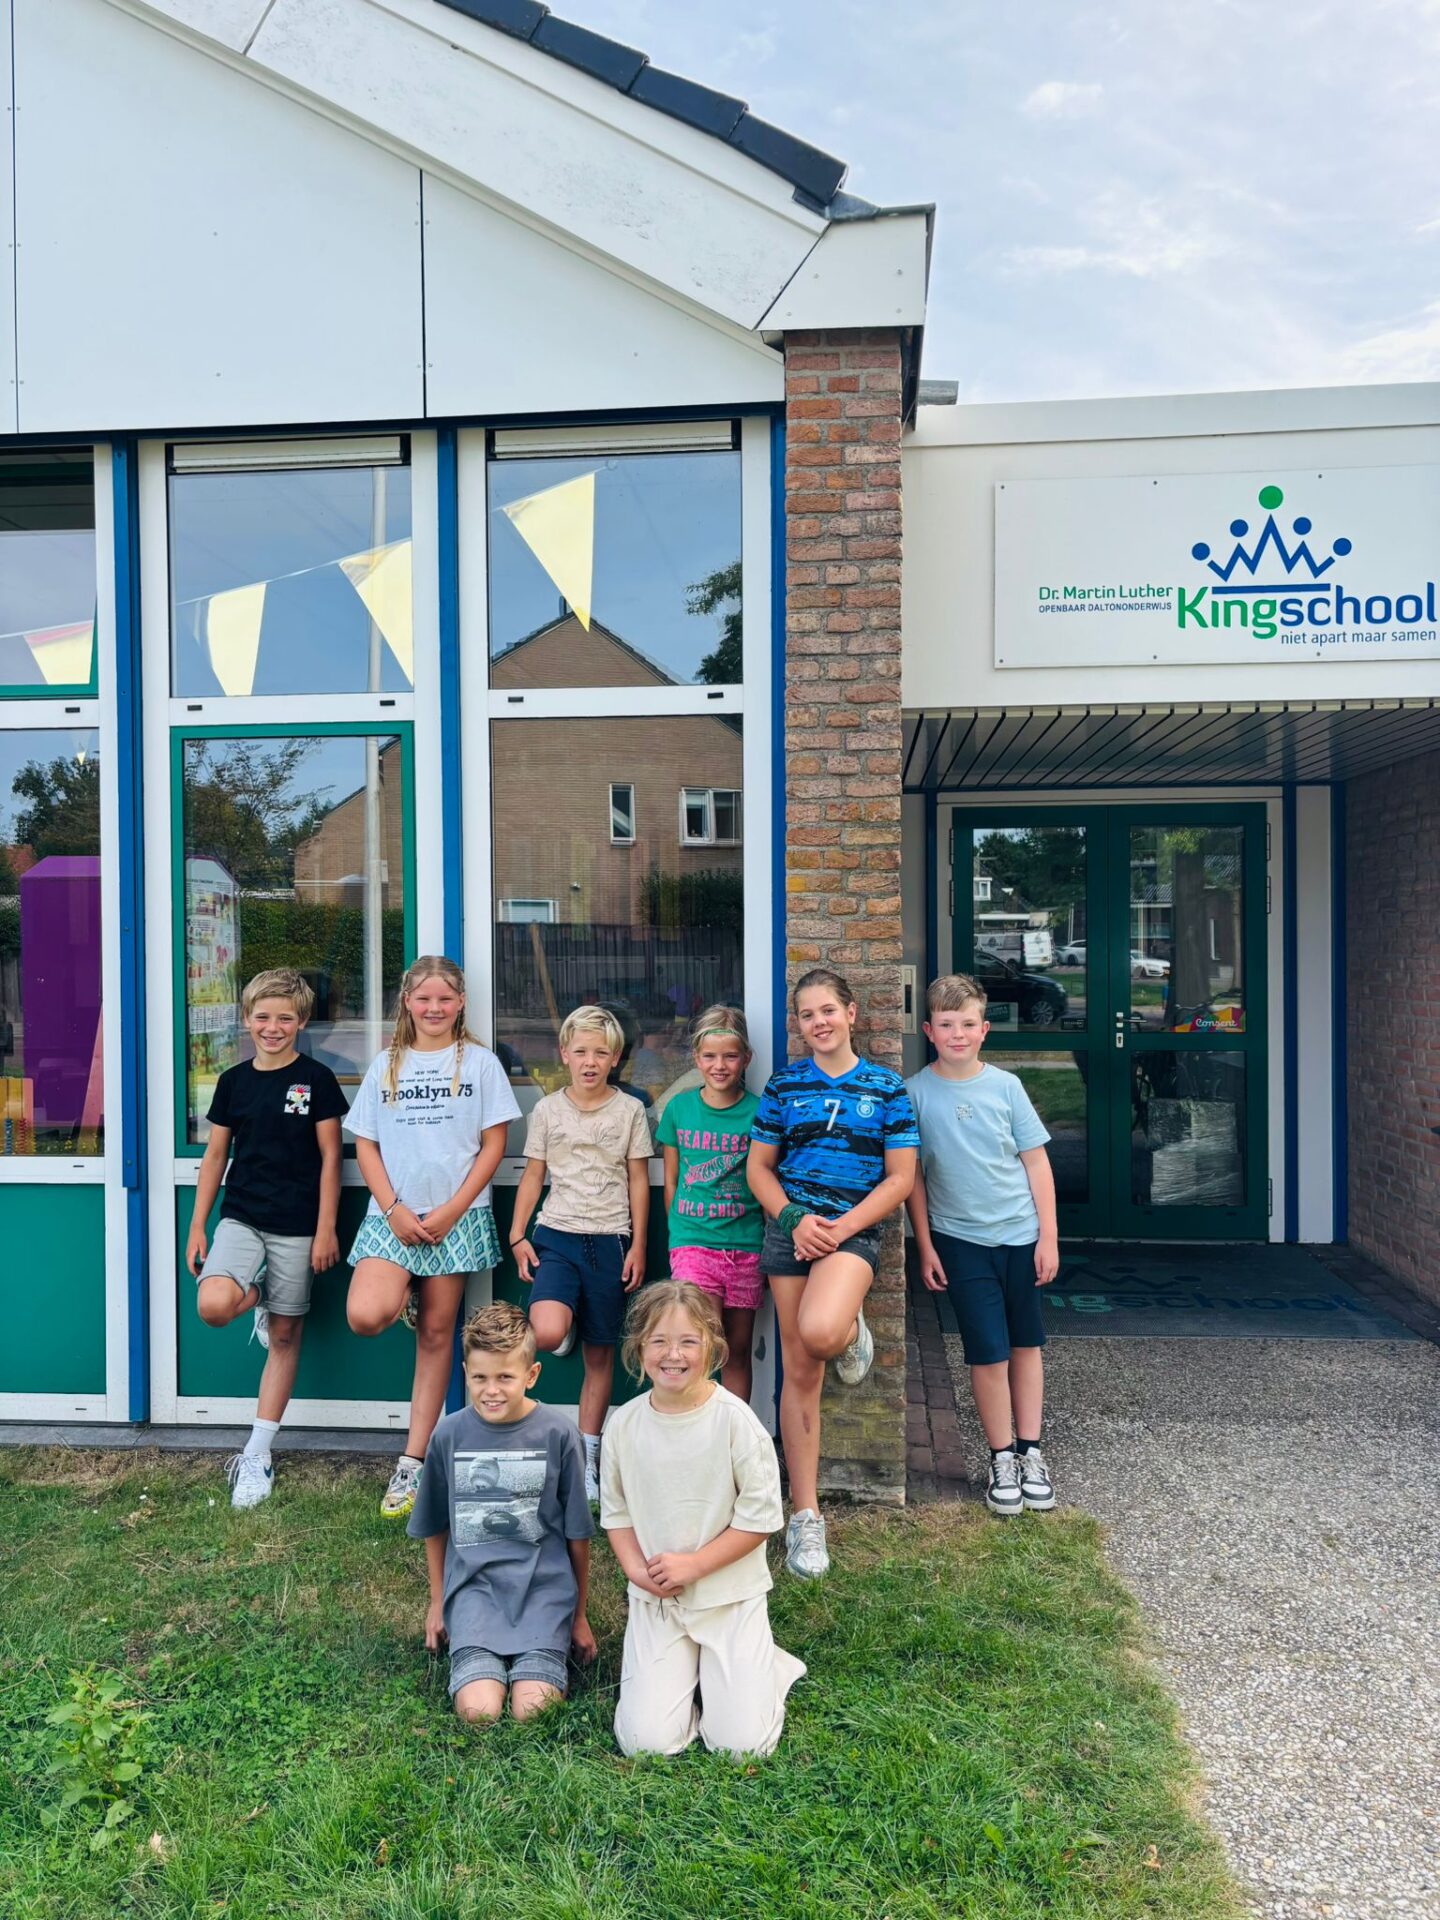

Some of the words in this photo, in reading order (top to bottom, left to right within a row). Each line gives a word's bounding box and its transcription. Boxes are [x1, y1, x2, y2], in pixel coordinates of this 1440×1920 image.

[1038, 586, 1060, 600] Dr.
[1063, 585, 1116, 600] Martin
[1119, 583, 1174, 599] Luther
[1038, 603, 1086, 614] OPENBAAR
[1088, 602, 1172, 612] DALTONONDERWIJS
[1177, 581, 1438, 640] Kingschool
[1281, 631, 1307, 645] niet
[1311, 631, 1348, 647] apart
[1352, 631, 1387, 643] maar
[1391, 629, 1437, 642] samen
[457, 1084, 473, 1097] 75
[824, 1098, 842, 1132] 7
[676, 1128, 748, 1153] FEARLESS
[709, 1201, 746, 1219] CHILD
